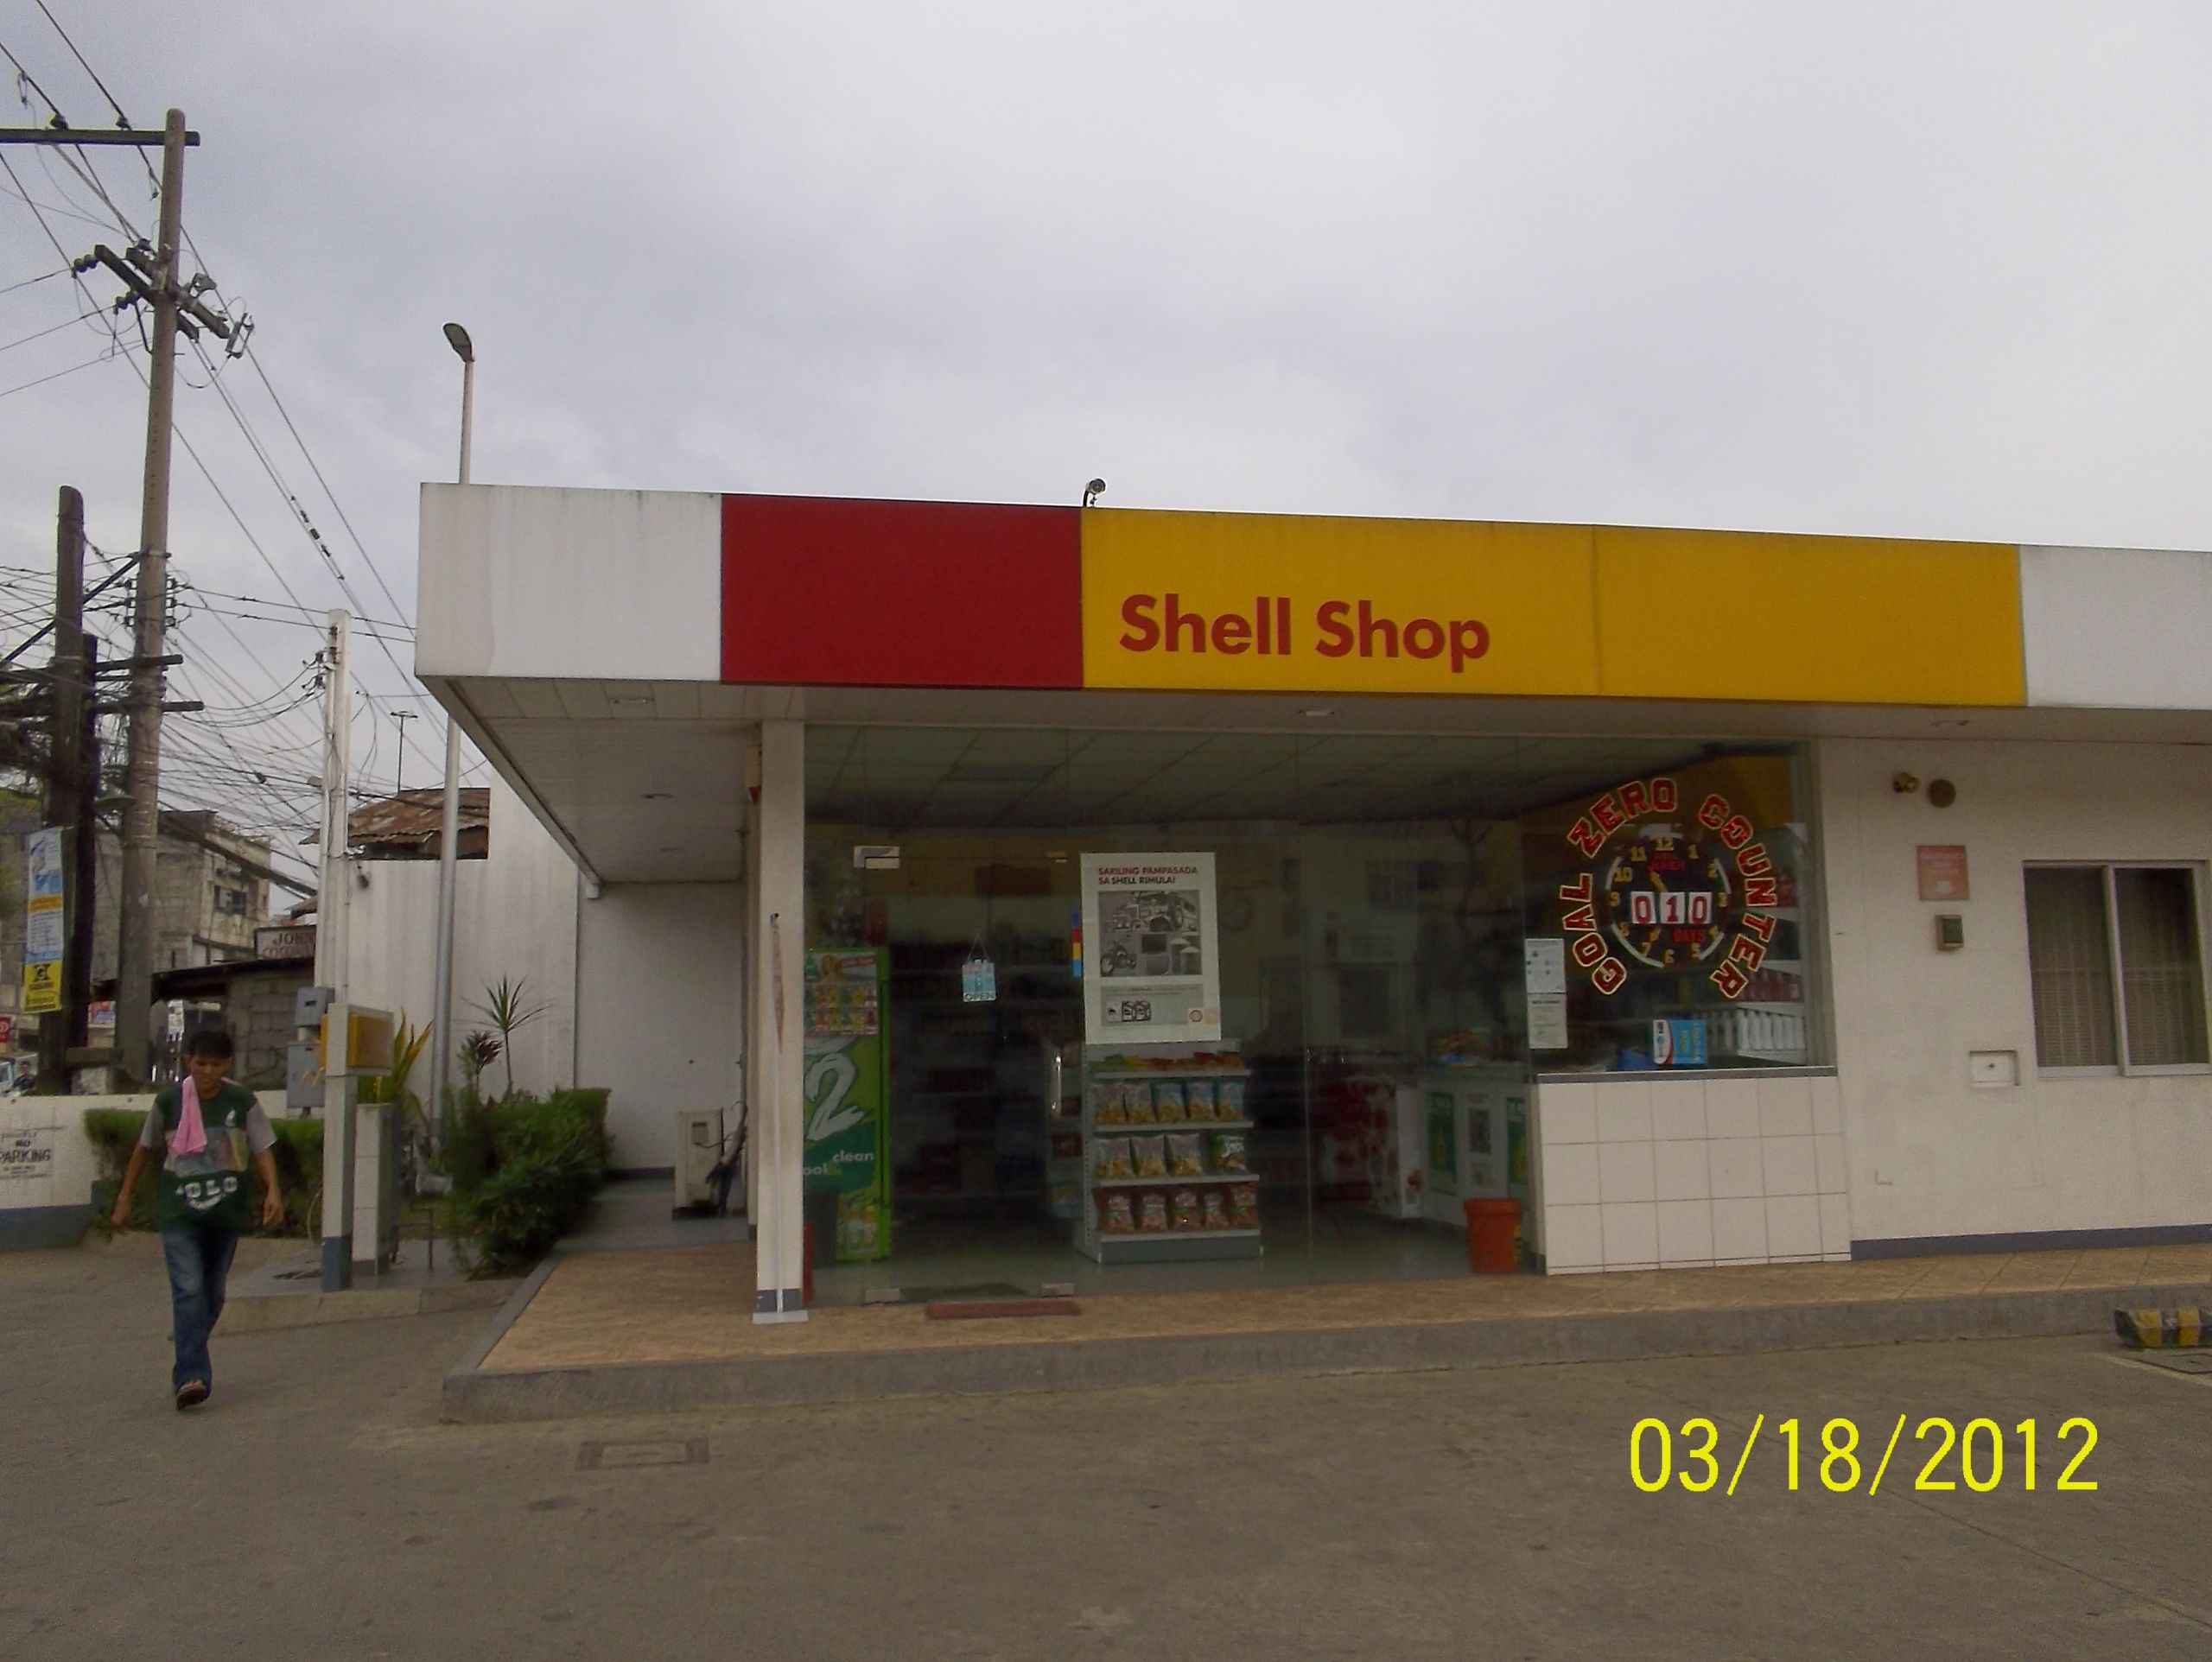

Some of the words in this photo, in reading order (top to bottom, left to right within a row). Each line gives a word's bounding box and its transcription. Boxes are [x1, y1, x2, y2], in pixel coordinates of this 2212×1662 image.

[1119, 593, 1292, 656] Shell
[1314, 599, 1490, 674] Shop
[1567, 777, 1678, 859] ZERO
[1630, 846, 1647, 861] 11
[1687, 844, 1699, 859] 1
[1613, 866, 1633, 883] 10
[1608, 891, 1620, 907] 9
[1698, 793, 1778, 999] COUNTER
[1634, 895, 1707, 924] 010
[1559, 872, 1627, 995] GOAL
[1673, 927, 1706, 943] DAYS
[1663, 948, 1675, 963] 6
[832, 1150, 874, 1163] clean
[803, 1163, 827, 1176] ool
